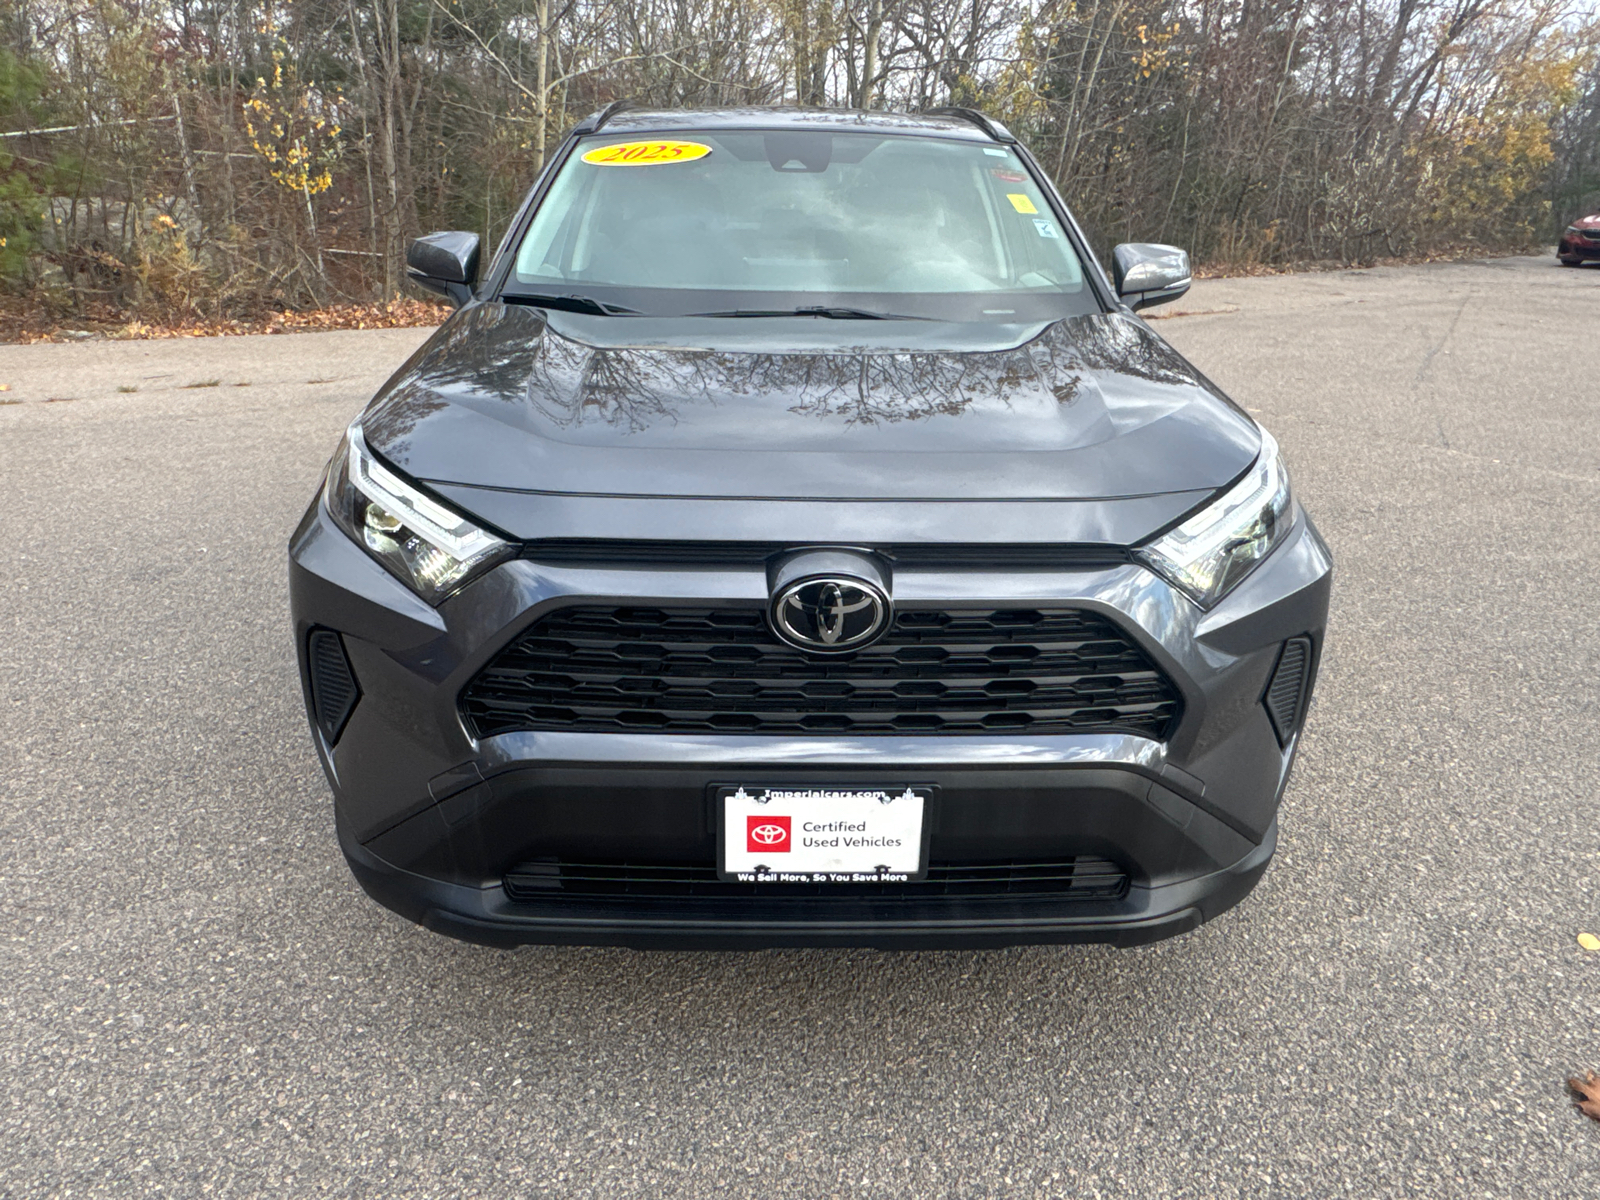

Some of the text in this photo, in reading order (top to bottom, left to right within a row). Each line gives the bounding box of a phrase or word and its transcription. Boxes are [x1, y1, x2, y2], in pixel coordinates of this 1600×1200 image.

[600, 145, 690, 162] 2025
[764, 789, 886, 800] Imperialcars.com
[803, 821, 866, 832] Certified
[803, 836, 902, 847] Used Vehicles
[738, 873, 908, 883] We Sell More, So You Save More
